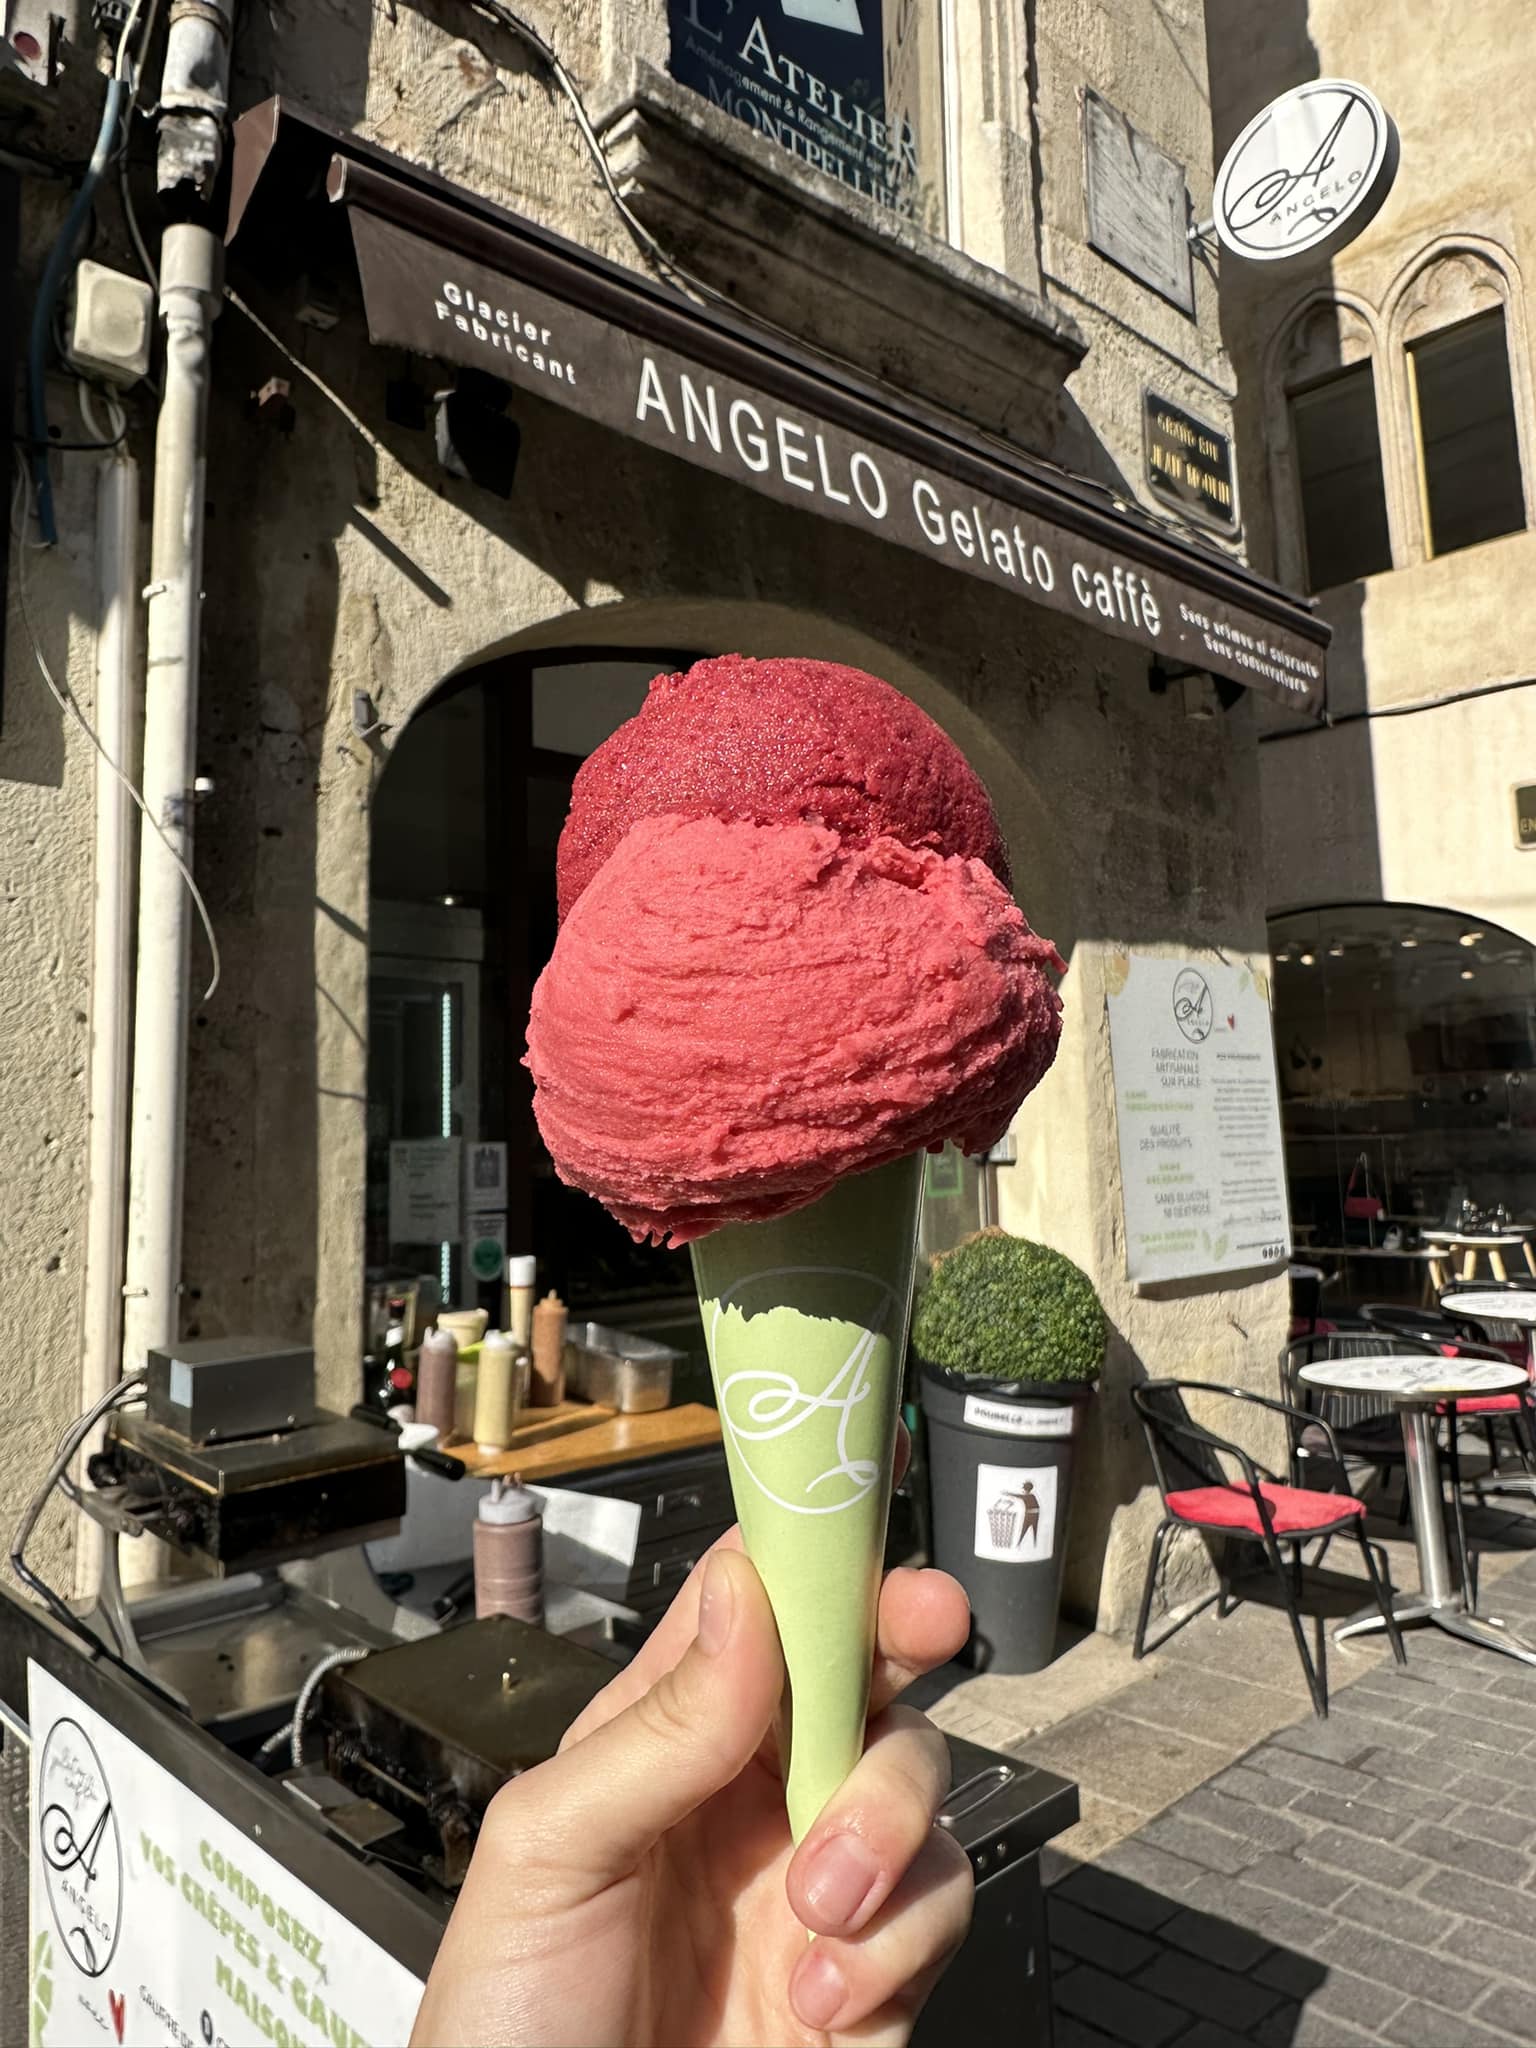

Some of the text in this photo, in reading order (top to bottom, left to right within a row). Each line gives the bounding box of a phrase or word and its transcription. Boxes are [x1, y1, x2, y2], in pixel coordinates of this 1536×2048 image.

[1269, 169, 1363, 226] ANGELO
[434, 299, 577, 385] Fabricant
[443, 281, 552, 346] Glacier
[635, 356, 1162, 637] ANGELO Gelato caffè
[1179, 602, 1210, 631] Sans
[1202, 630, 1232, 660] Sans
[139, 1829, 177, 1887] VOS
[179, 1869, 261, 1969] CRÊPES
[198, 1838, 324, 1969] COMPOSEZ
